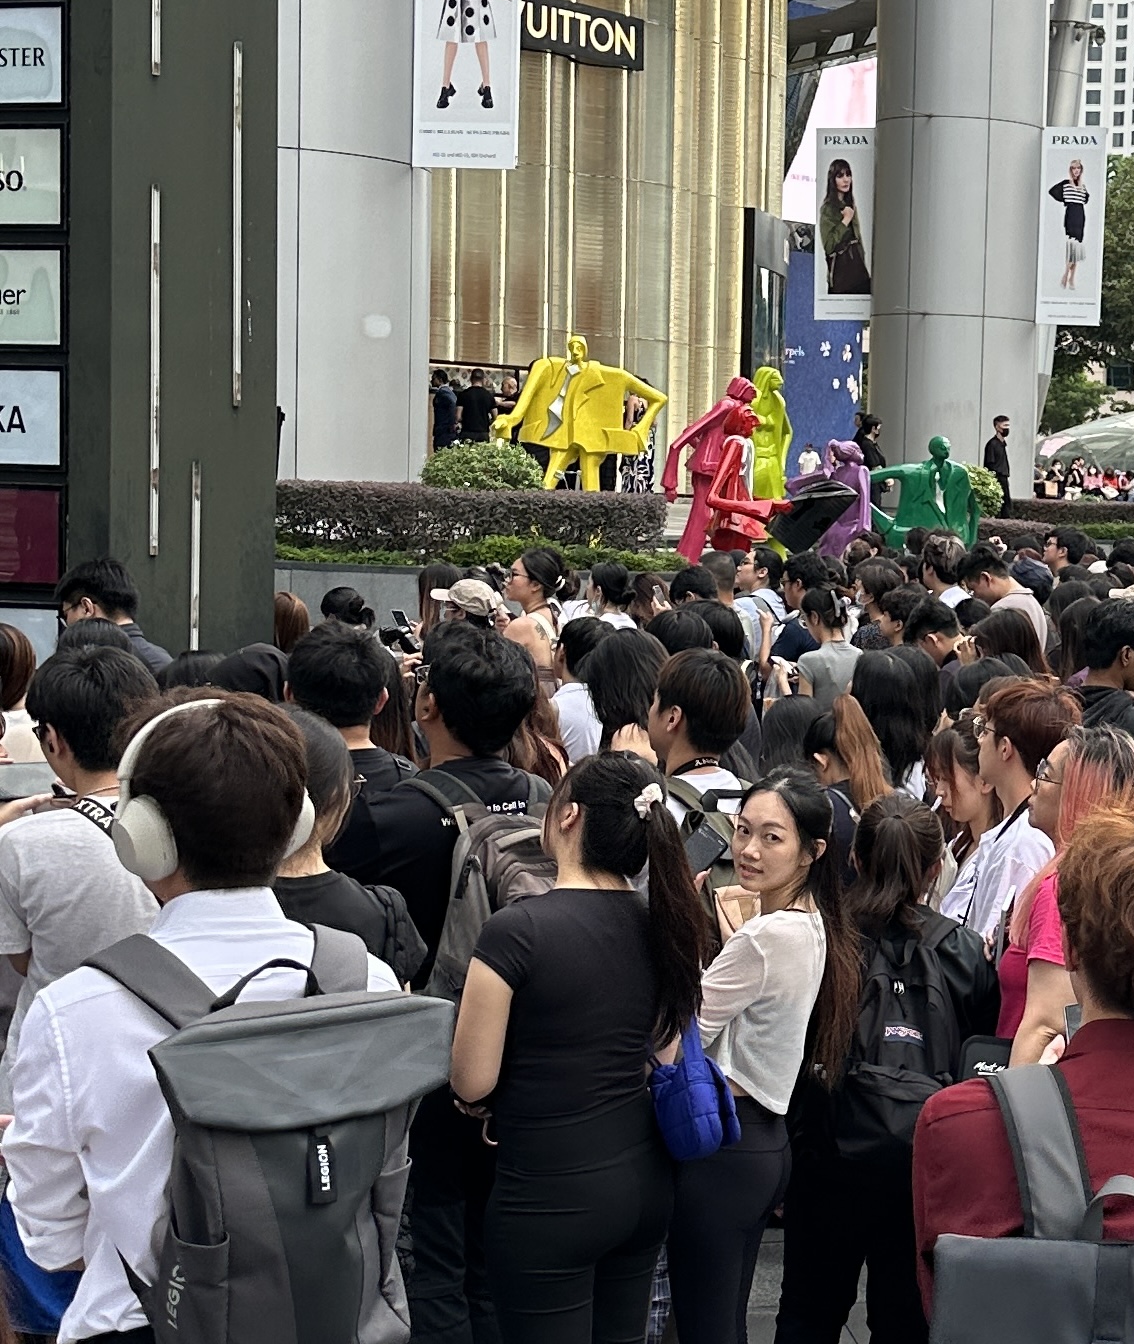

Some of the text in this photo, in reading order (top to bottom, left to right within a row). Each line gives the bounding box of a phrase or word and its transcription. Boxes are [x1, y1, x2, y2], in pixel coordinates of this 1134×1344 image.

[520, 0, 636, 61] UITTON
[824, 135, 869, 145] PRADA
[1052, 135, 1098, 145] PRADA
[0, 288, 27, 305] er
[316, 1144, 331, 1191] LEGION
